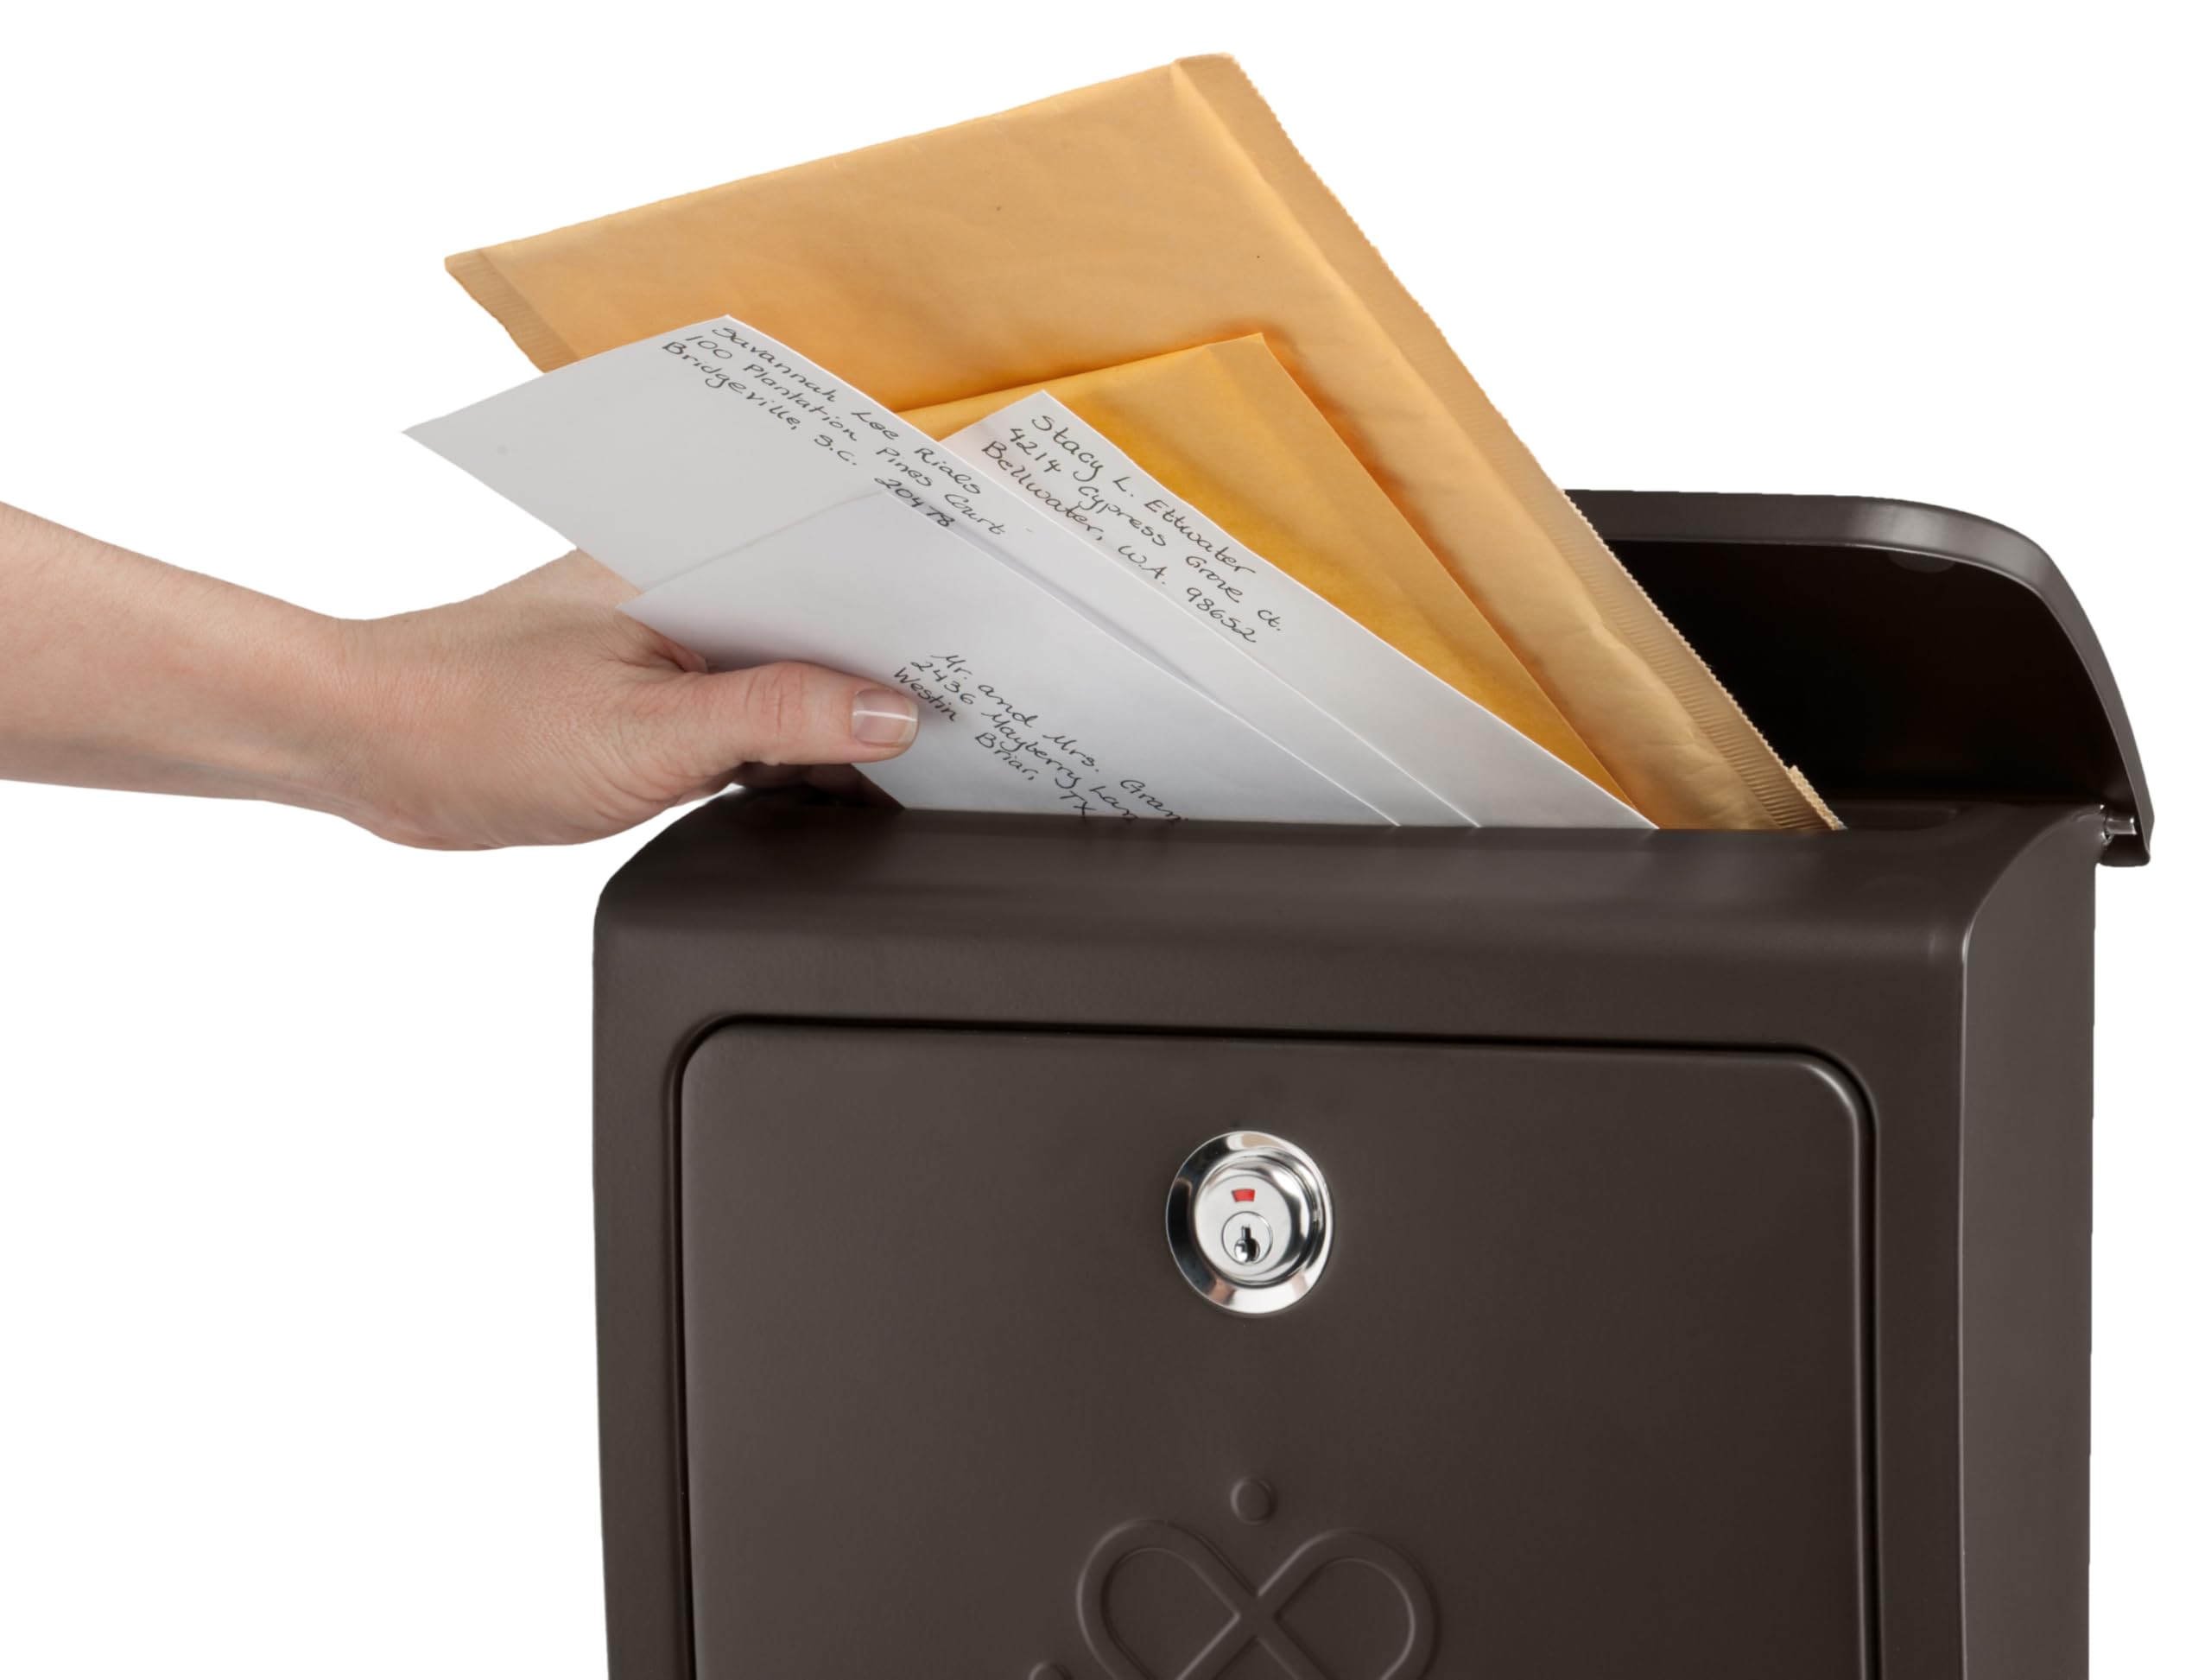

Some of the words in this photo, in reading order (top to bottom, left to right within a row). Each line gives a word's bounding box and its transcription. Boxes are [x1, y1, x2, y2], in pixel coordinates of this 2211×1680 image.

[685, 334, 732, 360] 100
[742, 364, 858, 441] Plantation
[876, 447, 933, 487] Pines
[712, 326, 837, 403] Savannah
[851, 410, 899, 441] Lee
[981, 440, 1104, 541] Bellwater,
[1118, 544, 1169, 585] W.A.
[1186, 586, 1257, 643] 98652
[1009, 427, 1062, 473] 4214
[1077, 485, 1167, 547] Cypress
[1185, 555, 1244, 604] Grove
[1031, 415, 1104, 482] Stacy
[1112, 475, 1135, 498] L.
[1144, 498, 1257, 574] Ettwater
[893, 666, 959, 723] Westin
[1059, 789, 1097, 818] TX
[909, 660, 975, 706] 2436
[980, 712, 1081, 789] Mayberry
[930, 654, 973, 680] Mr.
[978, 683, 1039, 728] and
[1042, 734, 1099, 772] Mrs.
